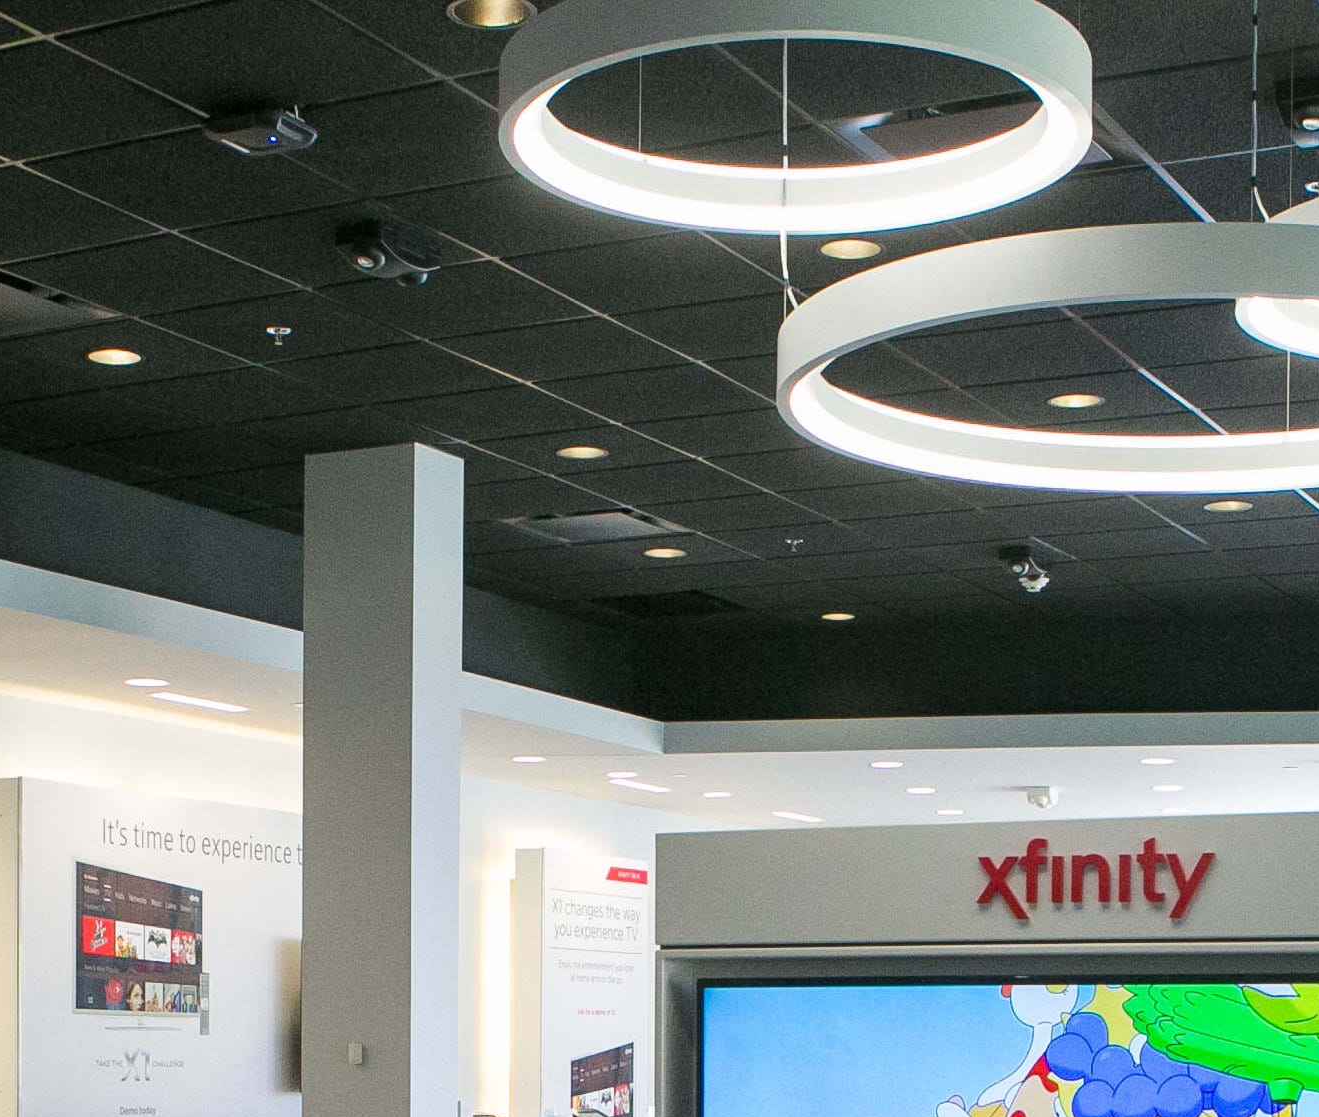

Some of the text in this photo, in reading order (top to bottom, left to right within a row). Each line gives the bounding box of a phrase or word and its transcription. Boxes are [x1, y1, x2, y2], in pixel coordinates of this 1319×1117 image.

[102, 818, 128, 846] It's
[133, 822, 174, 852] time
[179, 829, 196, 853] to
[201, 835, 292, 865] experience
[976, 837, 1216, 921] xfinity
[552, 898, 641, 923] X1 changes the way
[554, 924, 639, 941] you experience TV
[119, 1105, 156, 1117] Demo today
